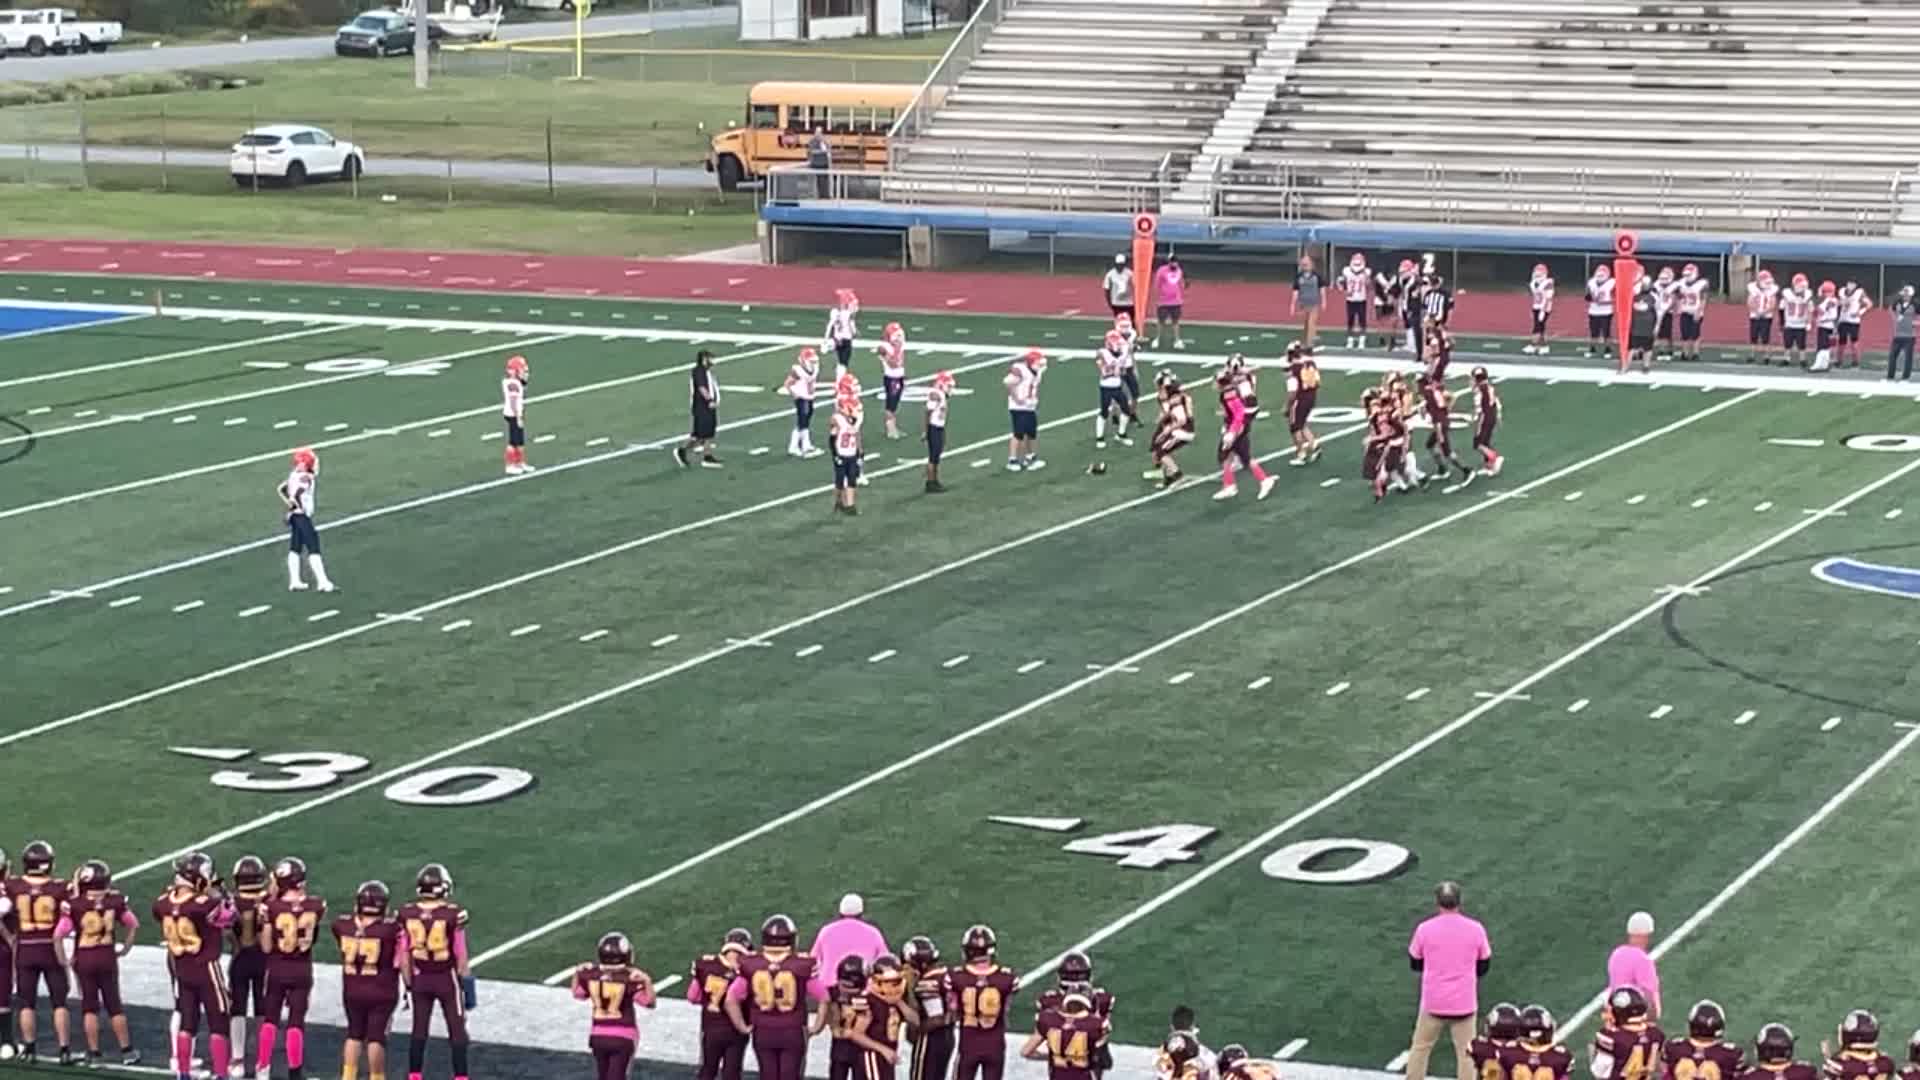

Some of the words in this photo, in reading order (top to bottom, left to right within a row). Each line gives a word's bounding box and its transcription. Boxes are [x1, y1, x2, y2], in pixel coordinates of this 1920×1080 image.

[210, 751, 533, 804] 30
[1062, 823, 1411, 883] 40
[588, 981, 626, 1020] 17
[1047, 1027, 1089, 1069] 14
